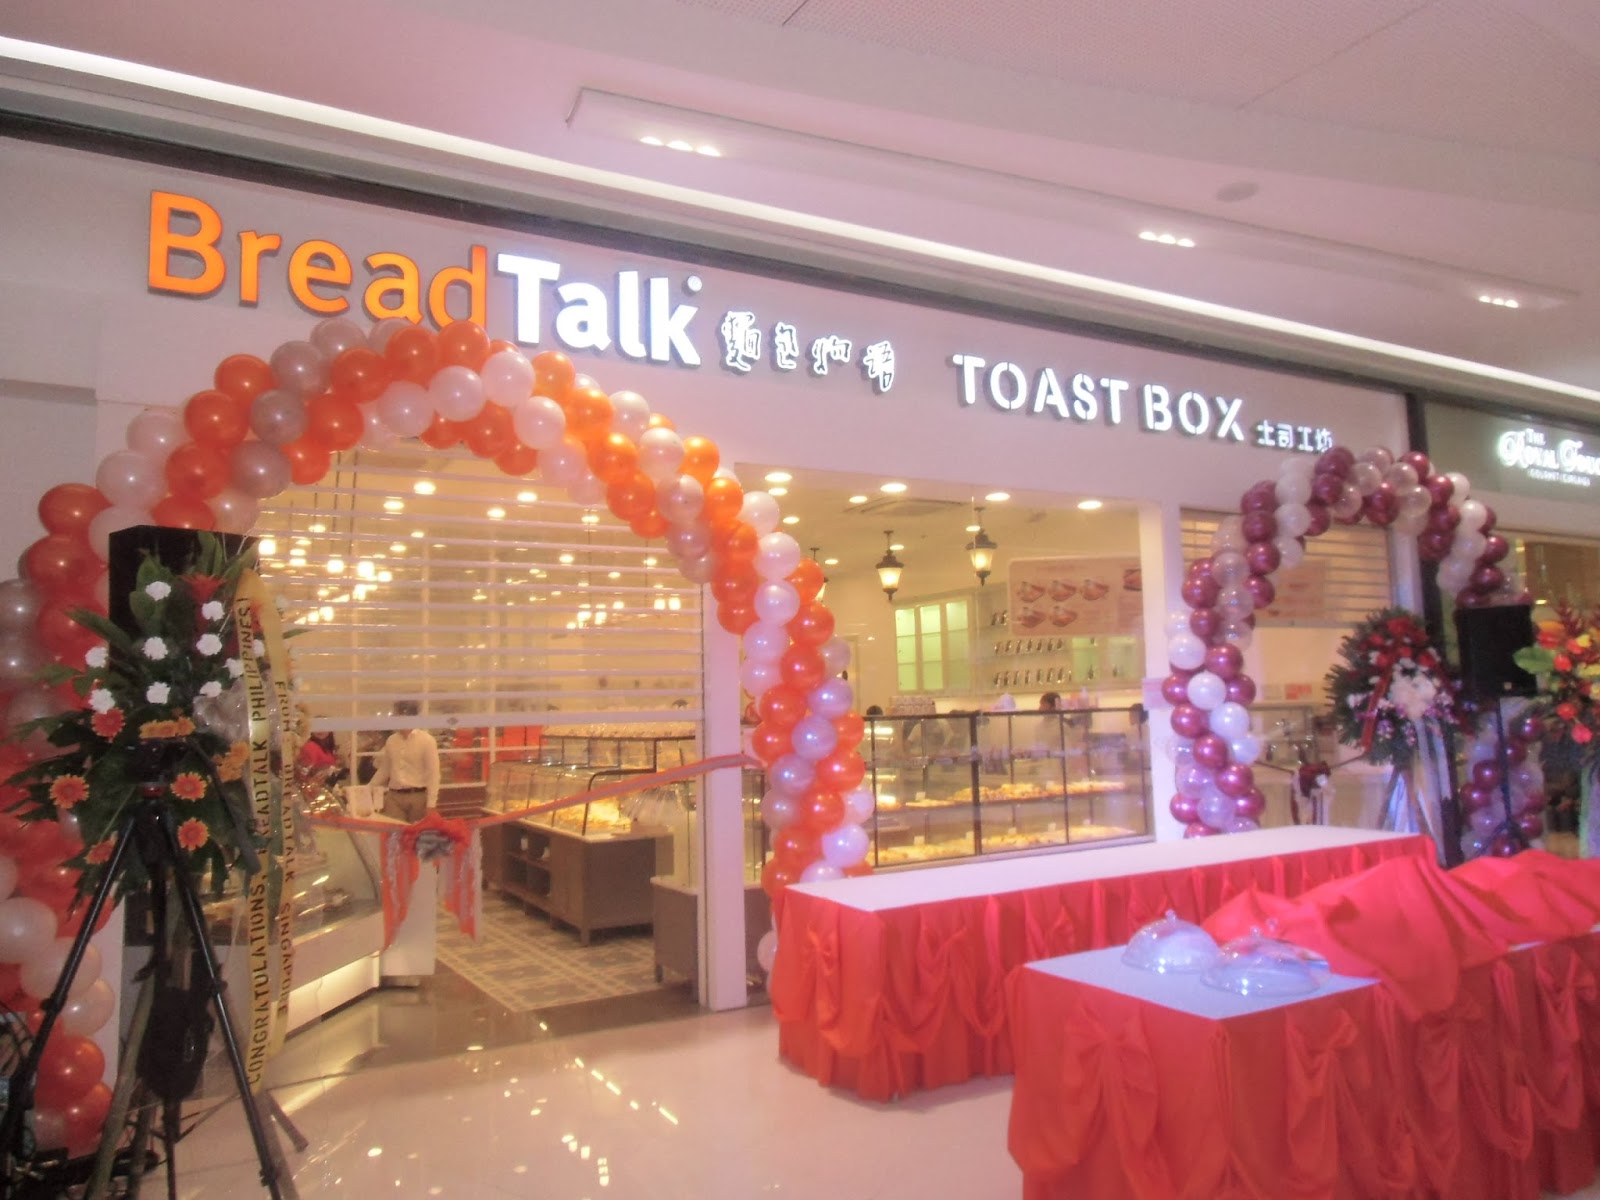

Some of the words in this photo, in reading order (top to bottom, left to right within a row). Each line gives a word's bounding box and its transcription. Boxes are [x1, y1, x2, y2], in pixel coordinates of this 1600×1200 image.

[148, 190, 703, 366] BreadTalk
[951, 353, 1129, 424] TOAST
[1143, 383, 1245, 441] BOX
